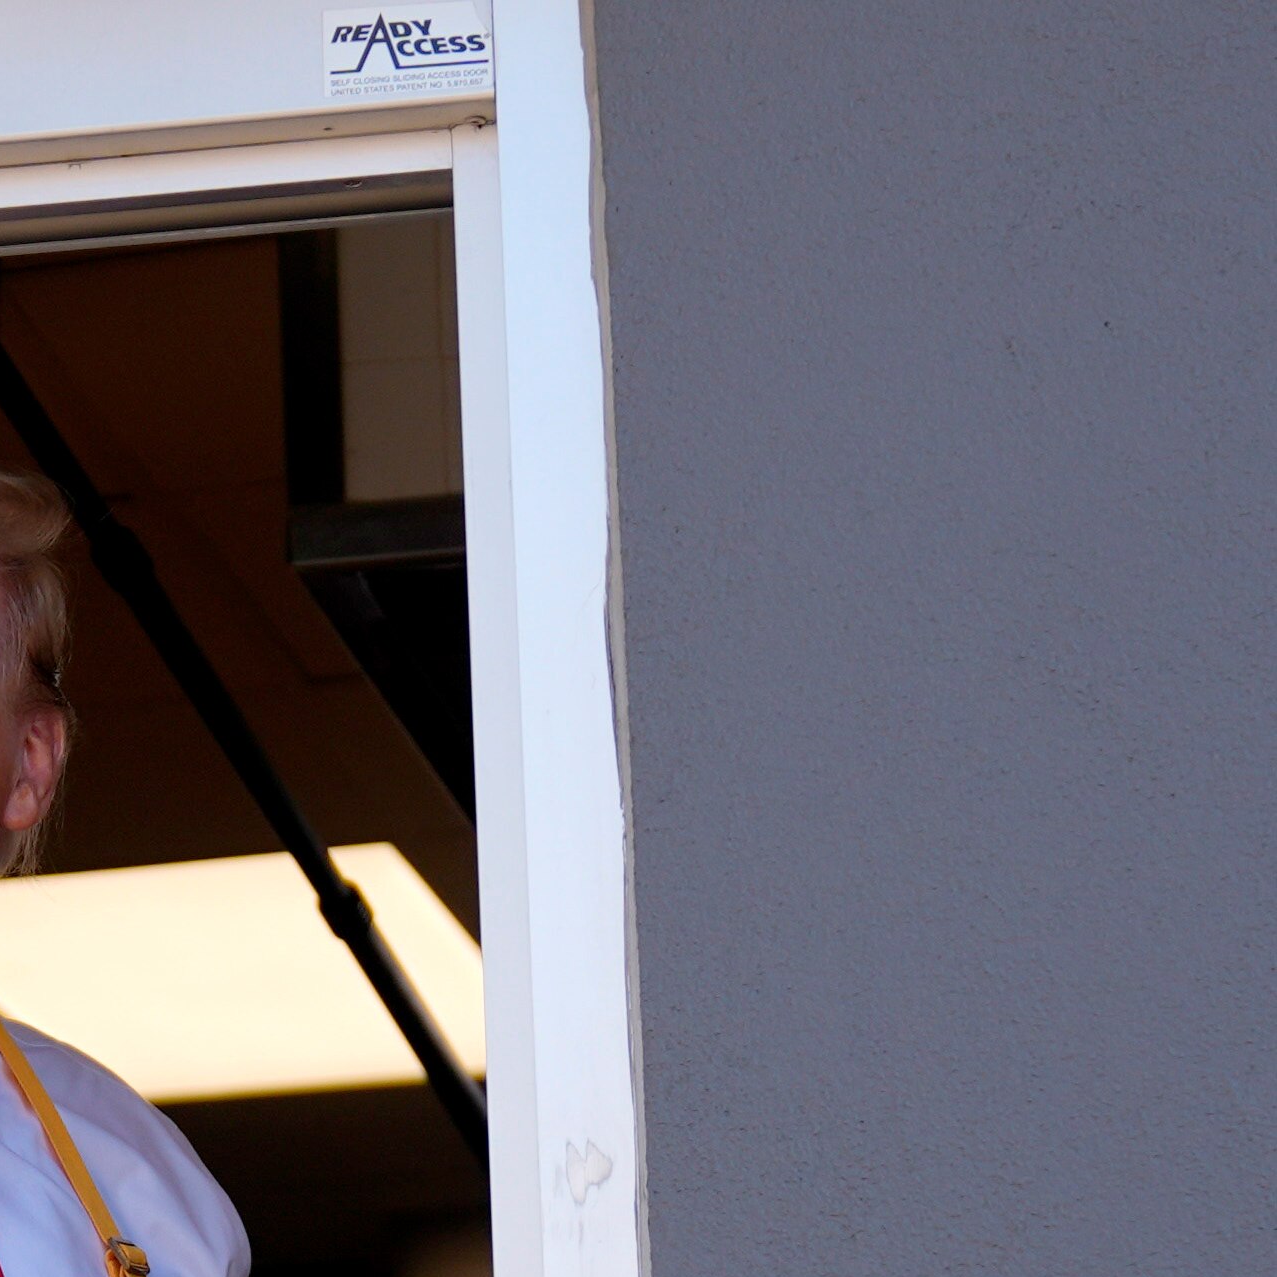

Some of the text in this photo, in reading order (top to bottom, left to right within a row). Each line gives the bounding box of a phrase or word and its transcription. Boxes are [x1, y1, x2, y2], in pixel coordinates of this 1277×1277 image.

[331, 13, 432, 44] READY
[428, 71, 461, 79] ACCESS
[330, 87, 361, 96] UNITED
[363, 84, 395, 94] STATES
[396, 82, 427, 91] PATENT
